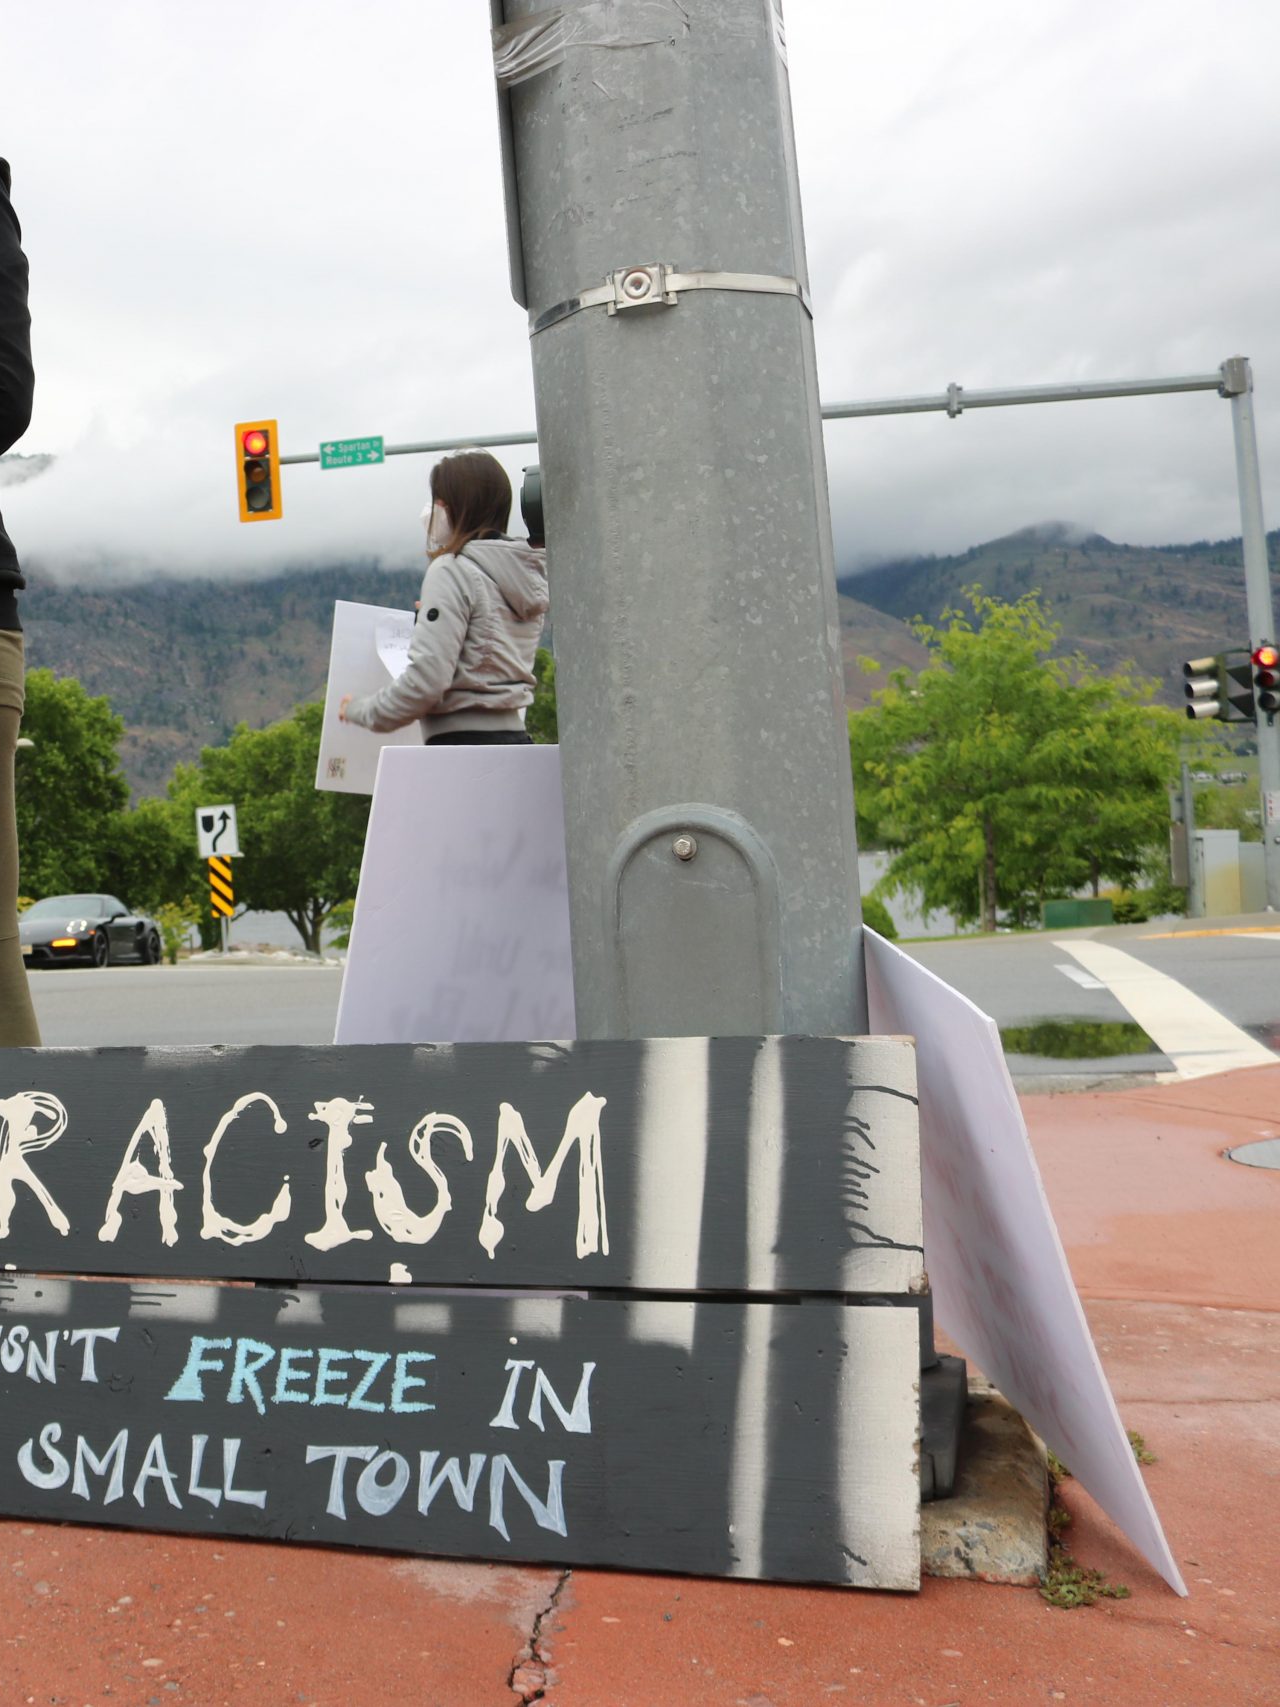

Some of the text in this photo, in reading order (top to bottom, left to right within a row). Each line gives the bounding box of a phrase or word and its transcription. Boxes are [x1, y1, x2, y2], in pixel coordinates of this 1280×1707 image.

[326, 452, 363, 465] Route 3
[338, 441, 370, 452] Spartan
[163, 1336, 436, 1414] FREEZE
[489, 1358, 596, 1434] IN
[17, 1422, 267, 1509] SMALL
[305, 1445, 568, 1541] TOWN
